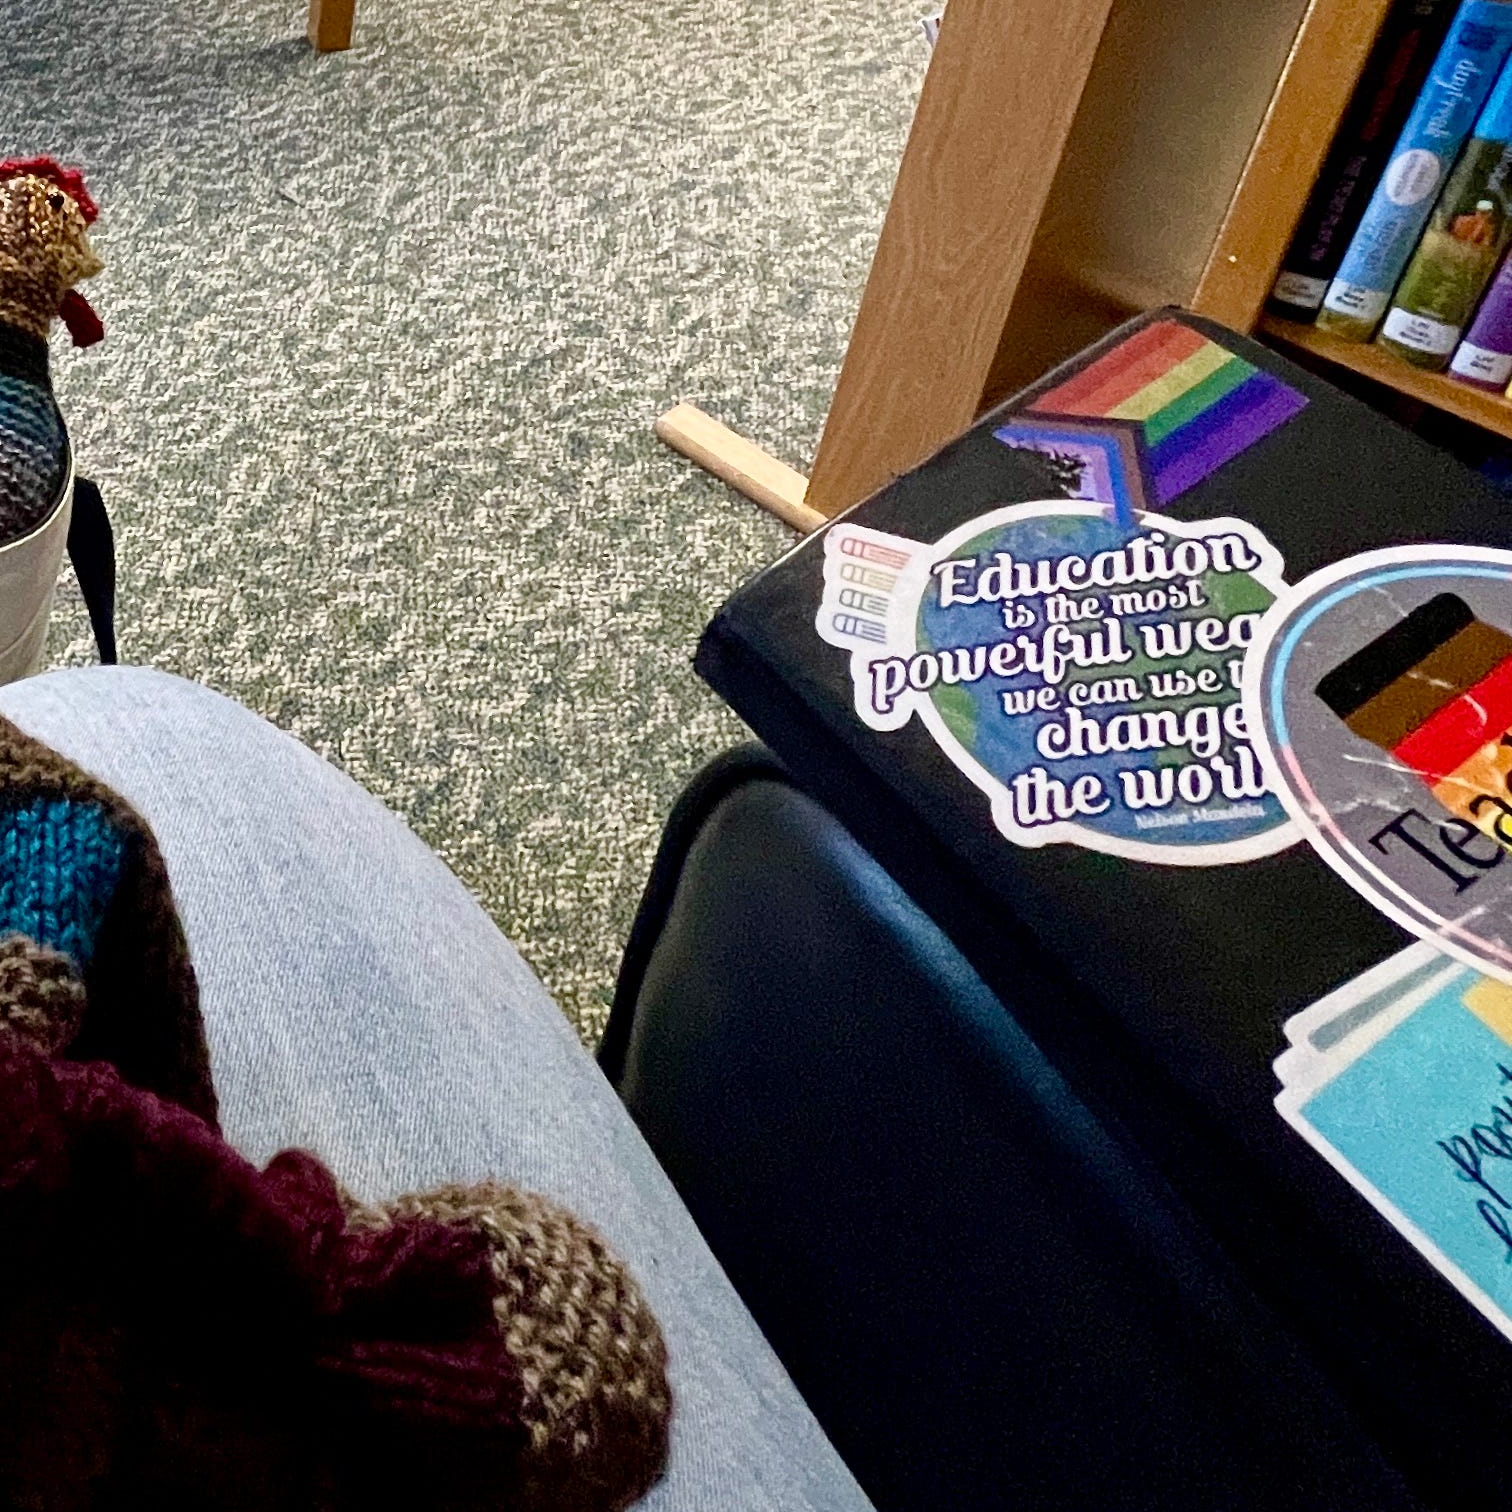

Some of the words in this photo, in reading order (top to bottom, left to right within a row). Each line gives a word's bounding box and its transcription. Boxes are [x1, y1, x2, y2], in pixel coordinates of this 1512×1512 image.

[933, 531, 1259, 606] Education
[1002, 600, 1036, 629] is
[1045, 592, 1104, 624] the
[1109, 579, 1206, 617] most
[870, 618, 1132, 714] powerful
[1140, 613, 1261, 659] wea
[1002, 687, 1061, 716] we
[1068, 676, 1144, 707] can
[1149, 666, 1224, 698] use
[1036, 702, 1249, 759] change
[1014, 766, 1110, 827] the
[1118, 744, 1268, 809] worl
[1134, 811, 1189, 830] Nelson
[1191, 804, 1266, 823] Mandela
